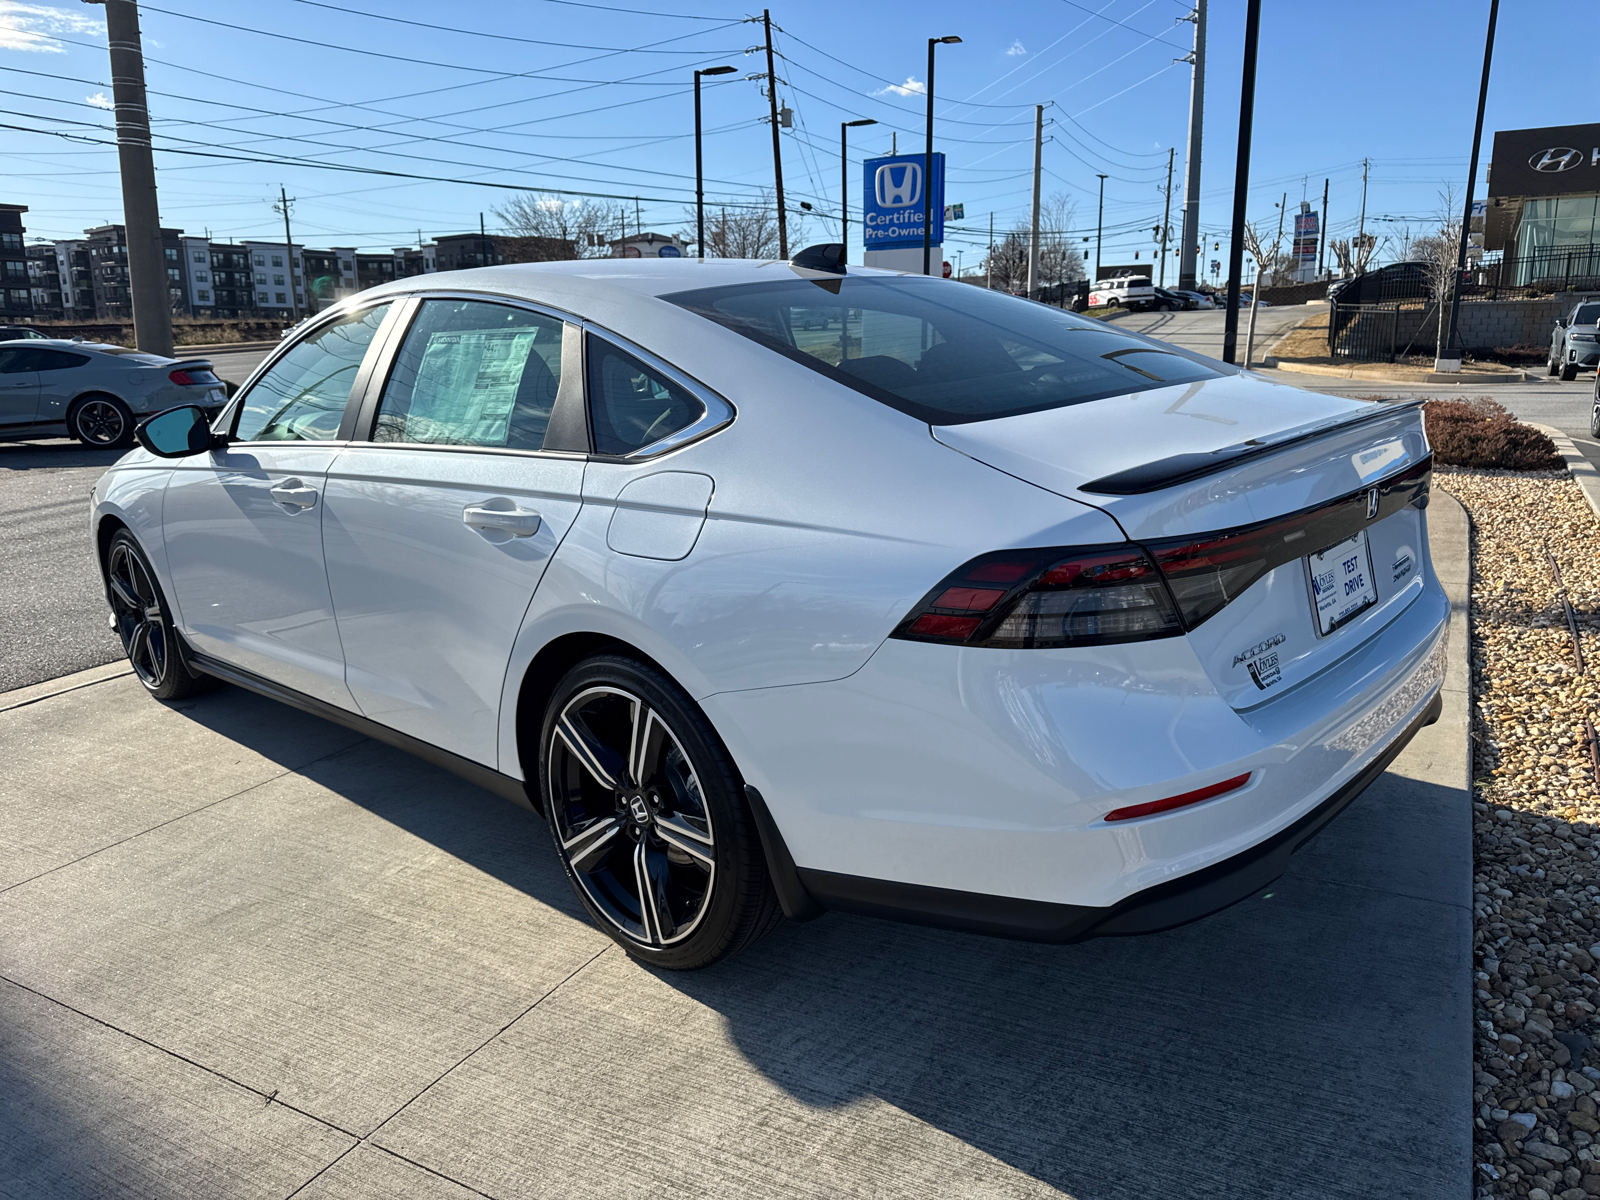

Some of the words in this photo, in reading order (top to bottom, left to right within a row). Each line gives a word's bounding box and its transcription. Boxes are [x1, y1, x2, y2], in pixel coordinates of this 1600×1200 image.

[1342, 555, 1358, 575] TEST
[1344, 573, 1364, 596] DRIVE
[1231, 632, 1286, 669] ACCORD
